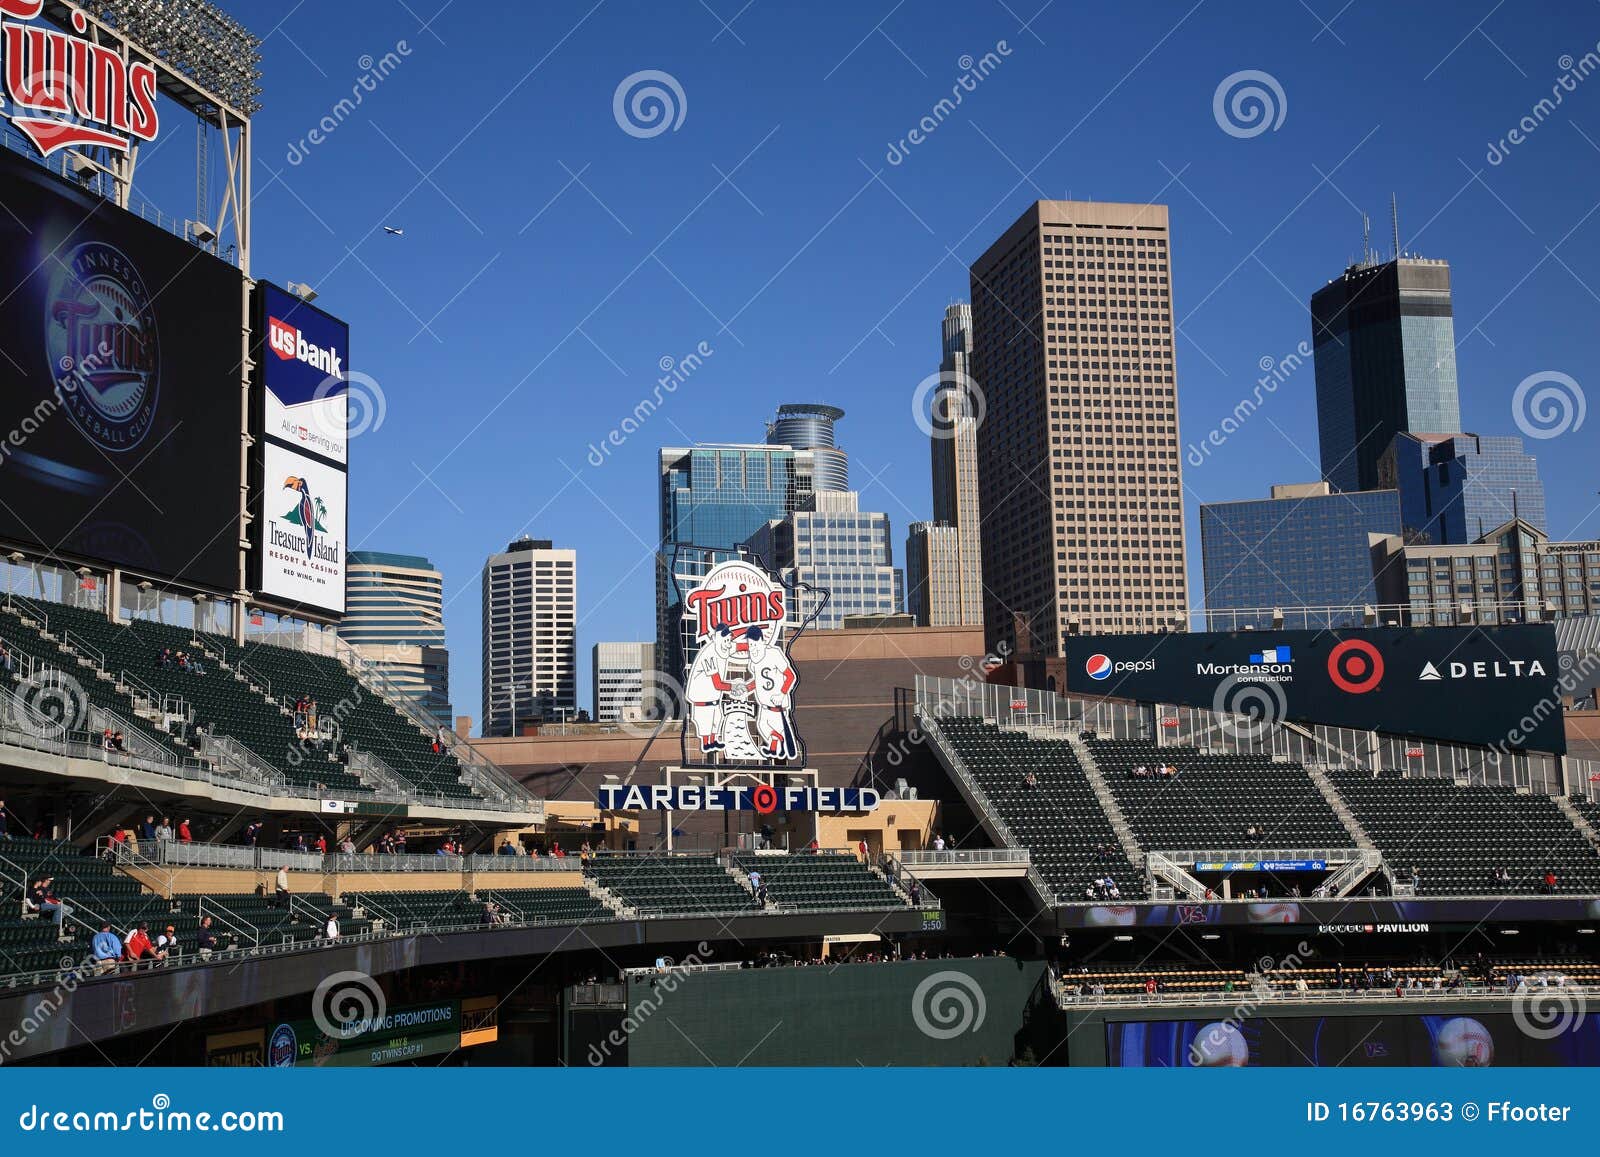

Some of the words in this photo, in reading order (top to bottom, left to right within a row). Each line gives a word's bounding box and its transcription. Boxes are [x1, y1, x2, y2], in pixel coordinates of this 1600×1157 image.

[0, 0, 159, 142] wins
[282, 419, 290, 432] All
[290, 424, 298, 434] of
[308, 433, 330, 450] serving
[269, 520, 306, 554] Treasure
[314, 535, 339, 564] Island
[269, 550, 298, 565] RESORT
[310, 562, 338, 576] CASINO
[283, 568, 294, 577] RED
[688, 585, 784, 637] Twins
[1114, 659, 1155, 673] pepsi
[1197, 663, 1292, 676] Mortenson
[1450, 660, 1546, 678] DELTA
[1237, 674, 1292, 683] construction
[600, 785, 748, 809] TARGET
[785, 787, 880, 811] FIELD
[922, 912, 939, 920] TIME
[922, 920, 941, 930] 5:50
[1376, 923, 1429, 933] PAVILION
[341, 1016, 392, 1036] UPCOMING
[394, 1007, 452, 1028] PROMOTIONS
[382, 1047, 402, 1059] TWINS
[403, 1045, 415, 1056] CAP
